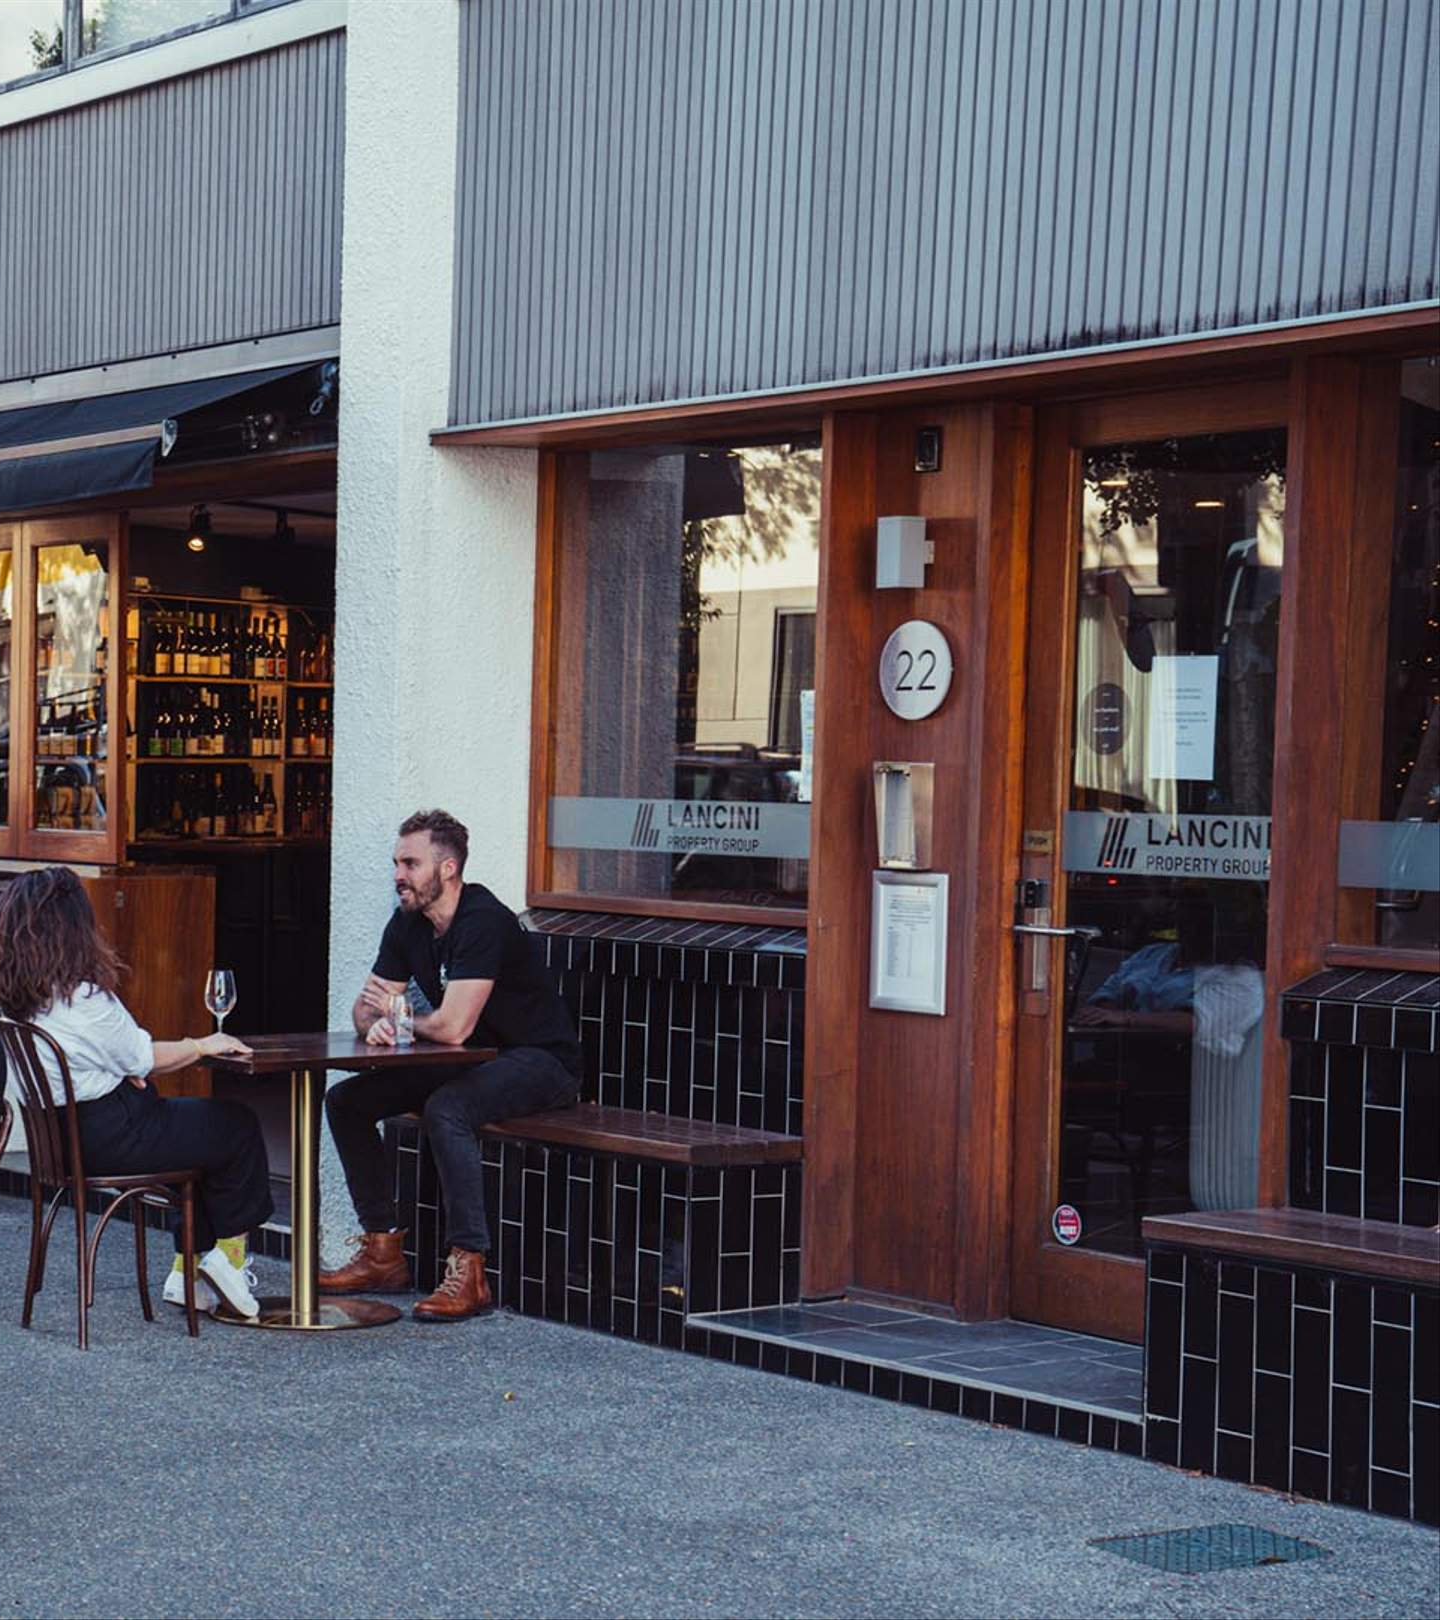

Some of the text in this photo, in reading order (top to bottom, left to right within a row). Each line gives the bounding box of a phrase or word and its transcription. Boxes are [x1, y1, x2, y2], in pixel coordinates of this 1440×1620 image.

[896, 650, 937, 691] 22
[667, 803, 760, 830] LANCINI
[667, 835, 760, 852] PROPERTY GROUP
[1146, 855, 1218, 873] PROPERTY
